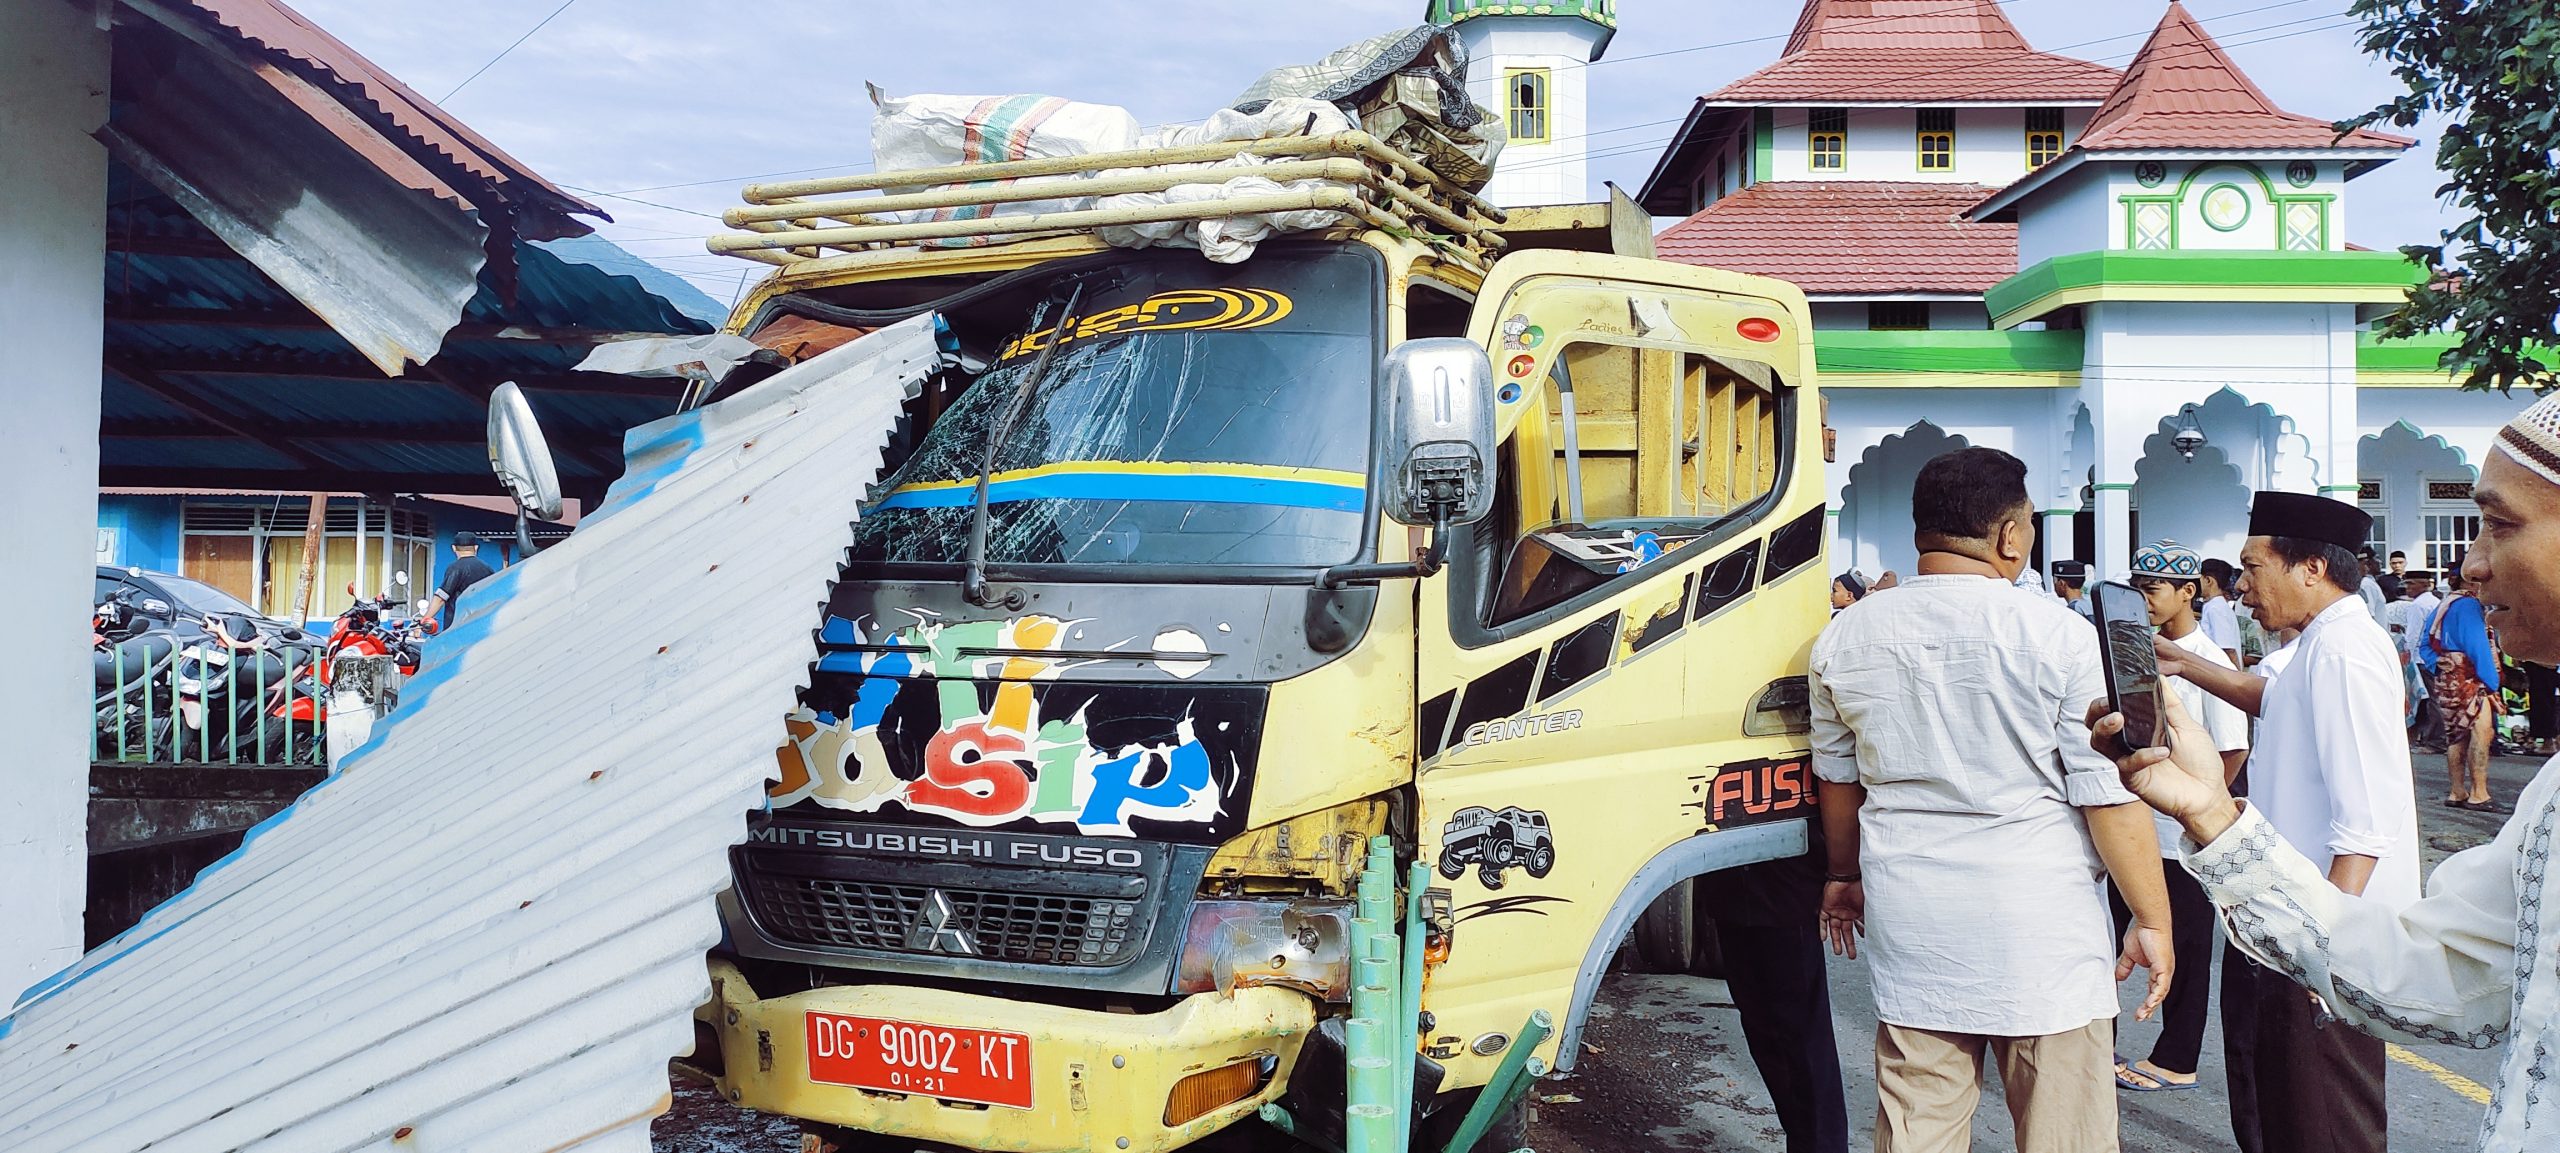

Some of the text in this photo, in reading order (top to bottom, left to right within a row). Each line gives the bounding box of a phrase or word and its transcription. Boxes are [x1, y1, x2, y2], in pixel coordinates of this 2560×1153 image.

[1463, 709, 1584, 746] CANTER
[749, 827, 1142, 867] MITSUBISHI FUSO
[815, 1016, 1019, 1081] DG 9002 KT
